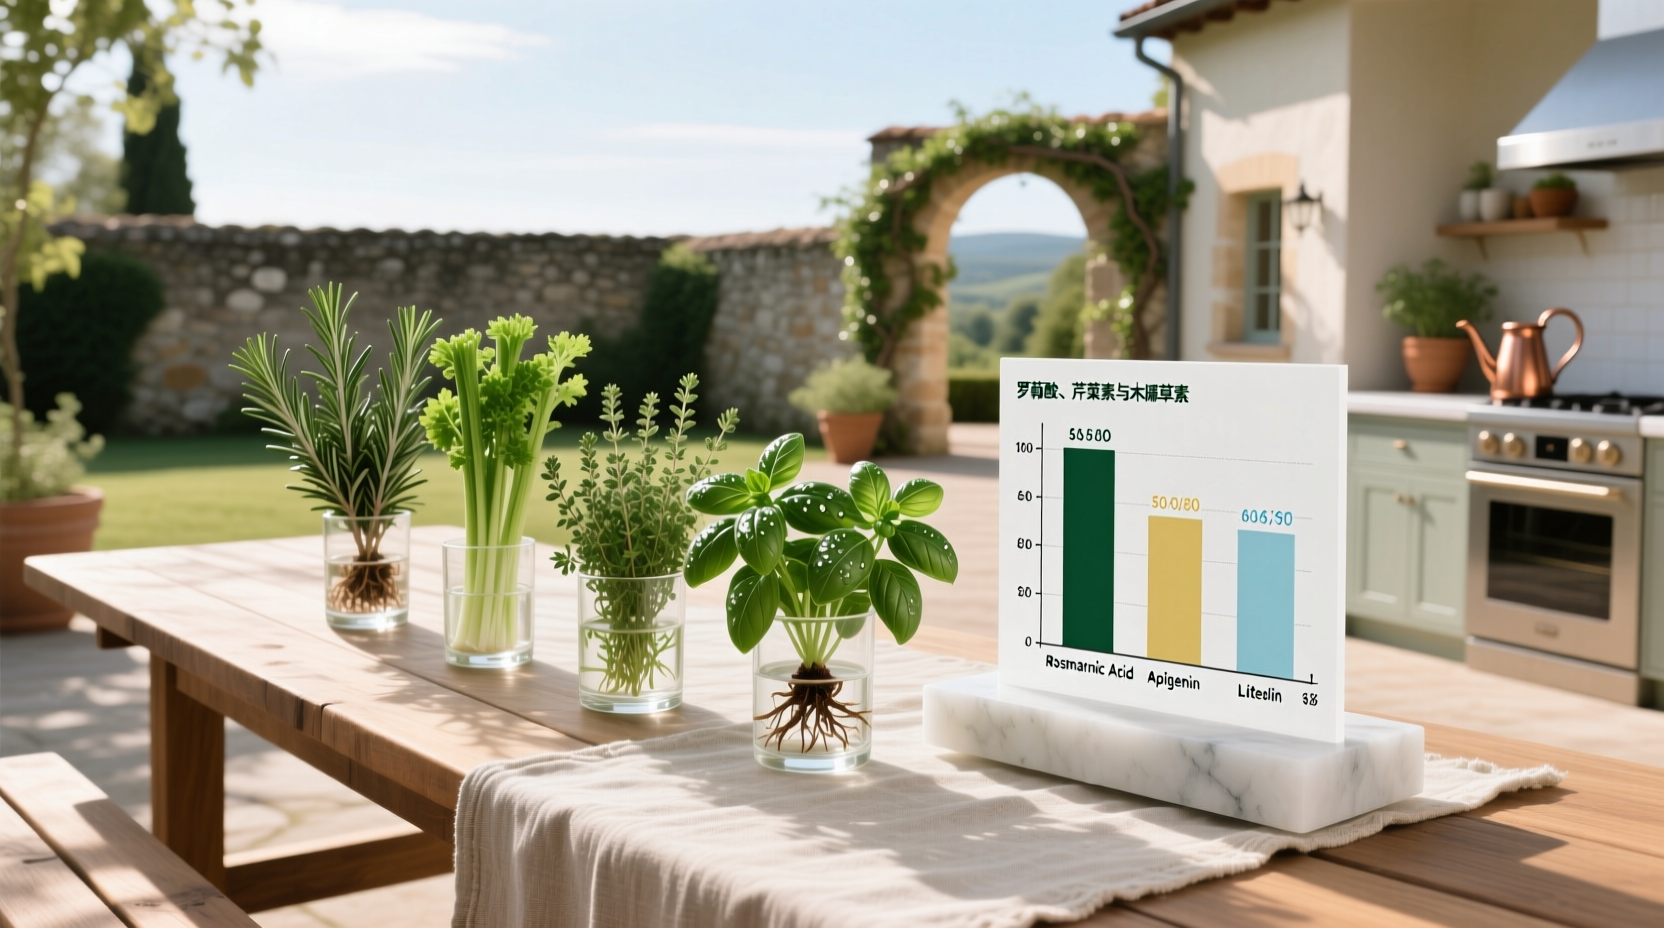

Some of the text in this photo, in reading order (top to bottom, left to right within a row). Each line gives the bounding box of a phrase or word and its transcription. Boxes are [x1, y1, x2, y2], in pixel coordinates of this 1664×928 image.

[1015, 441, 1033, 453] 100
[1025, 636, 1032, 647] 0
[1108, 663, 1134, 680] Acid
[1147, 670, 1201, 690] Apigenin
